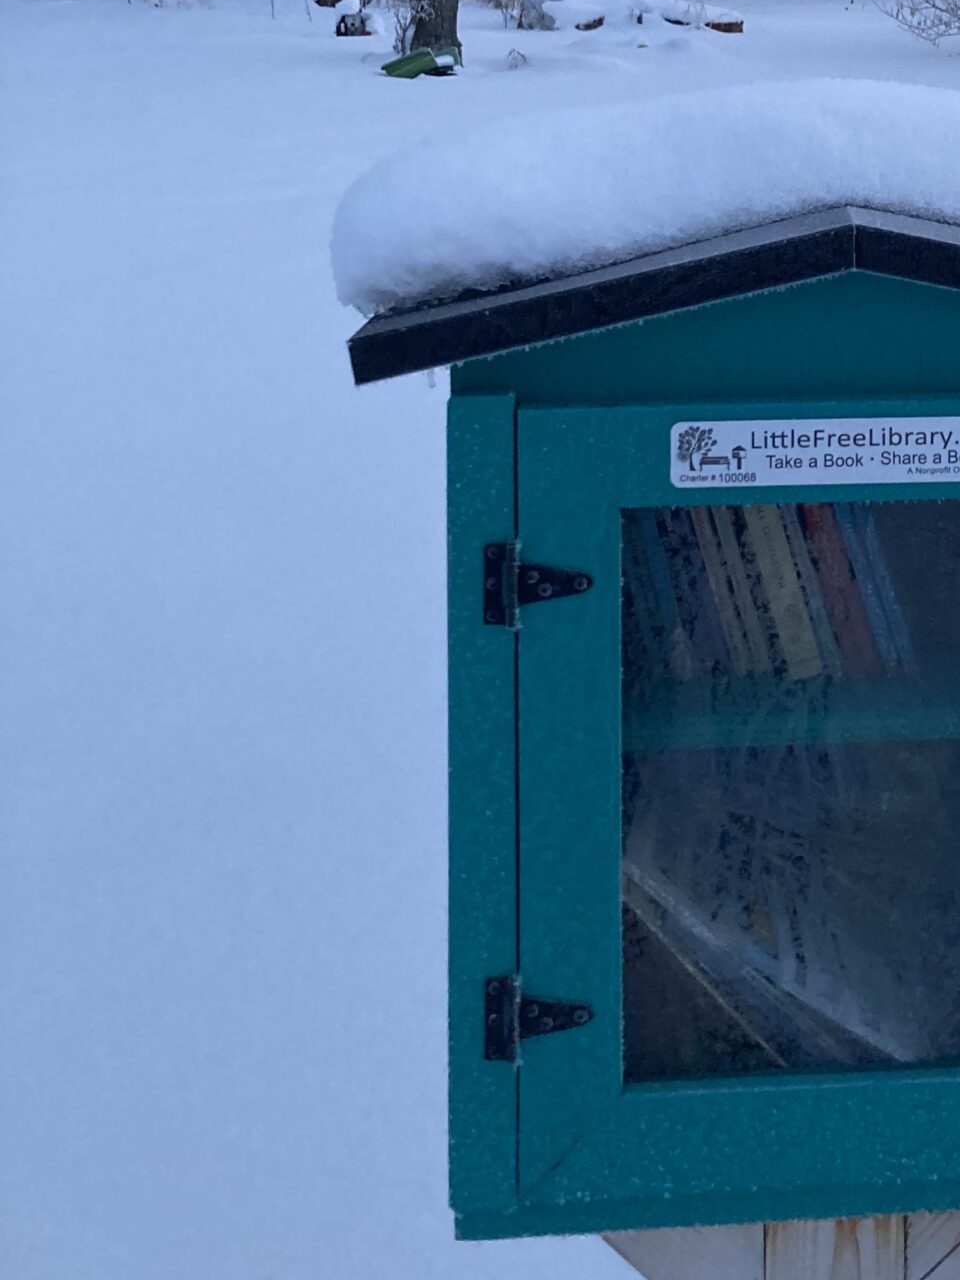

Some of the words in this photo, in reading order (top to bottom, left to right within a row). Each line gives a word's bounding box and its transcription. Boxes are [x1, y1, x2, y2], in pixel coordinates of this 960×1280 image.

[765, 453, 803, 469] Take
[808, 457, 818, 469] a
[823, 452, 864, 468] Book
[880, 450, 928, 466] Share
[932, 453, 942, 465] a
[907, 466, 914, 475] A
[915, 465, 951, 476] Nonprofit
[680, 473, 708, 483] Charter
